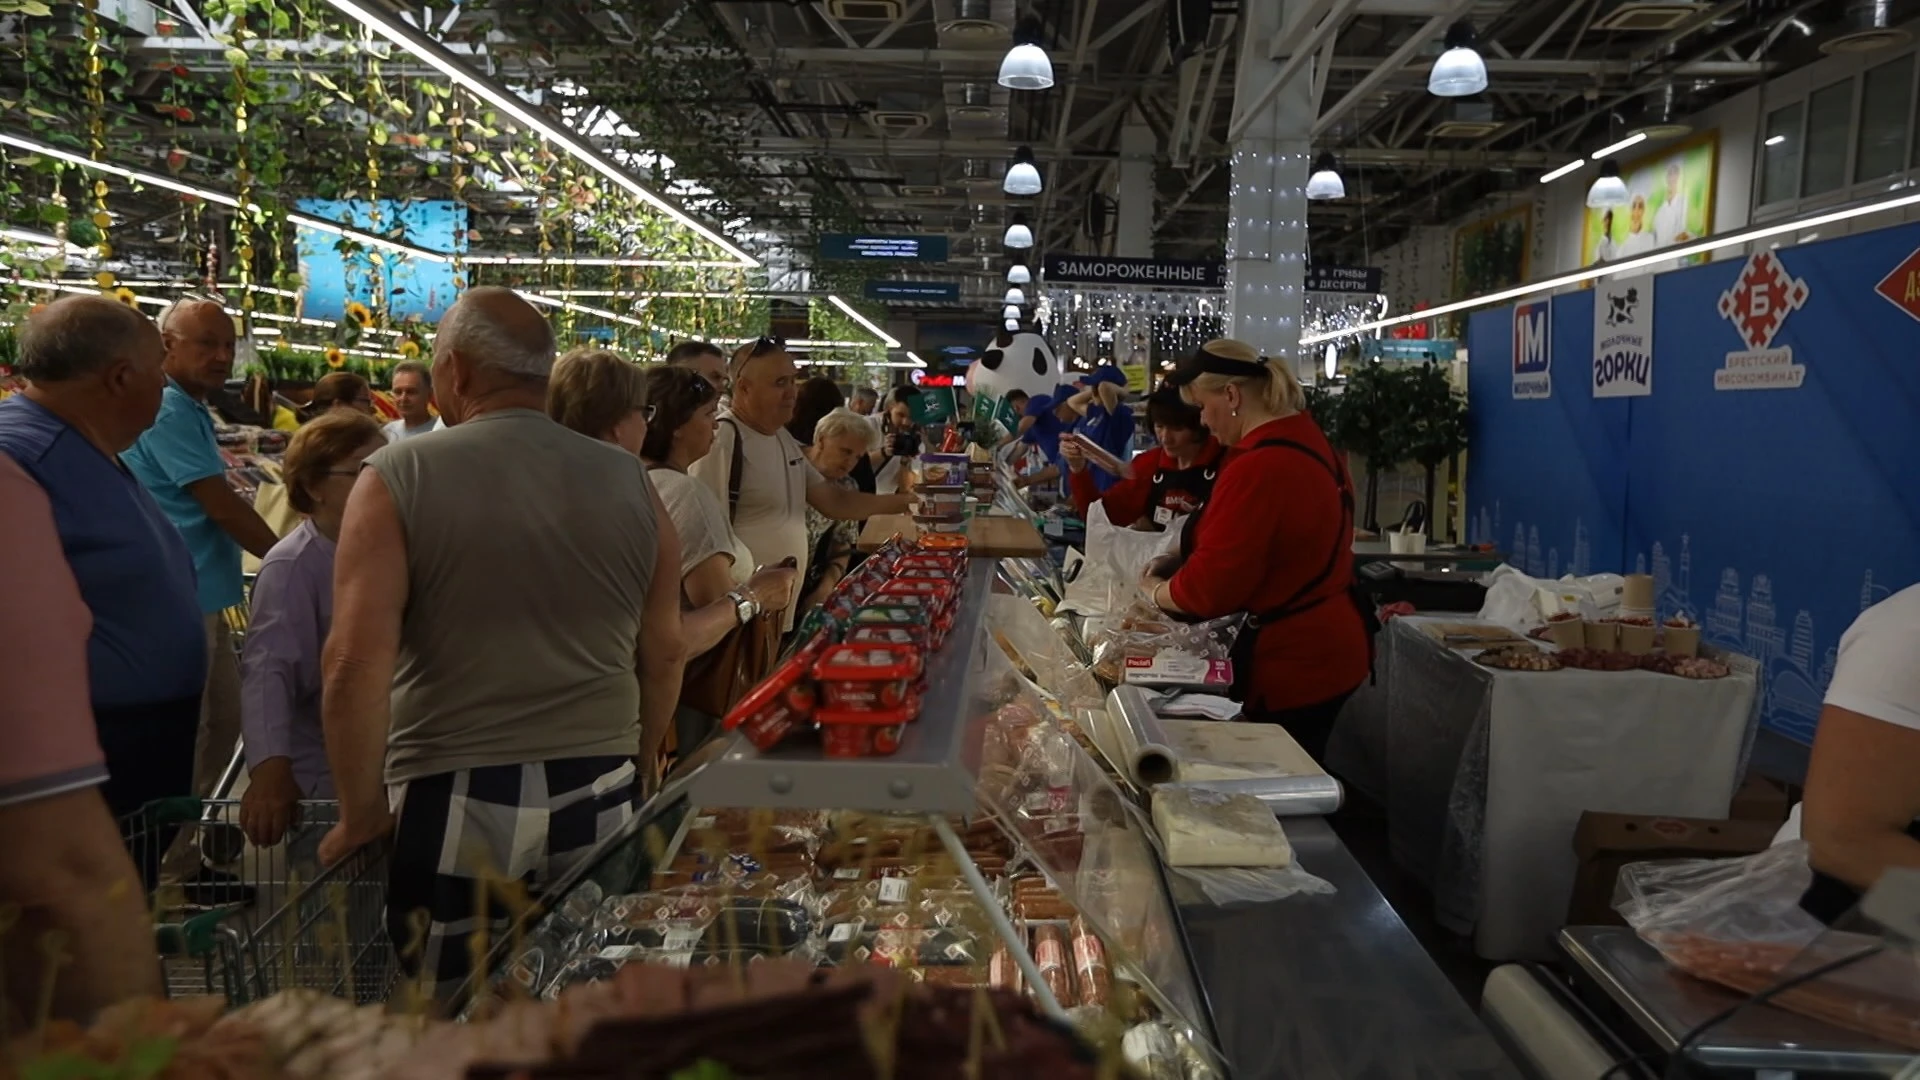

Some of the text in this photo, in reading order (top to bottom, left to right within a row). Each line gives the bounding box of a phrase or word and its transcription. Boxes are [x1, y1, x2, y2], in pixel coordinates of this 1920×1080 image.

[1057, 261, 1206, 280] ЗАМОРОЖЕННЫЕ
[1319, 280, 1367, 290] ДЕСЕРТЫ
[1750, 283, 1769, 317] Б
[1728, 352, 1788, 368] БРЕСТСКИЙ
[1716, 370, 1801, 384] МЯСОКОМБИНАТ
